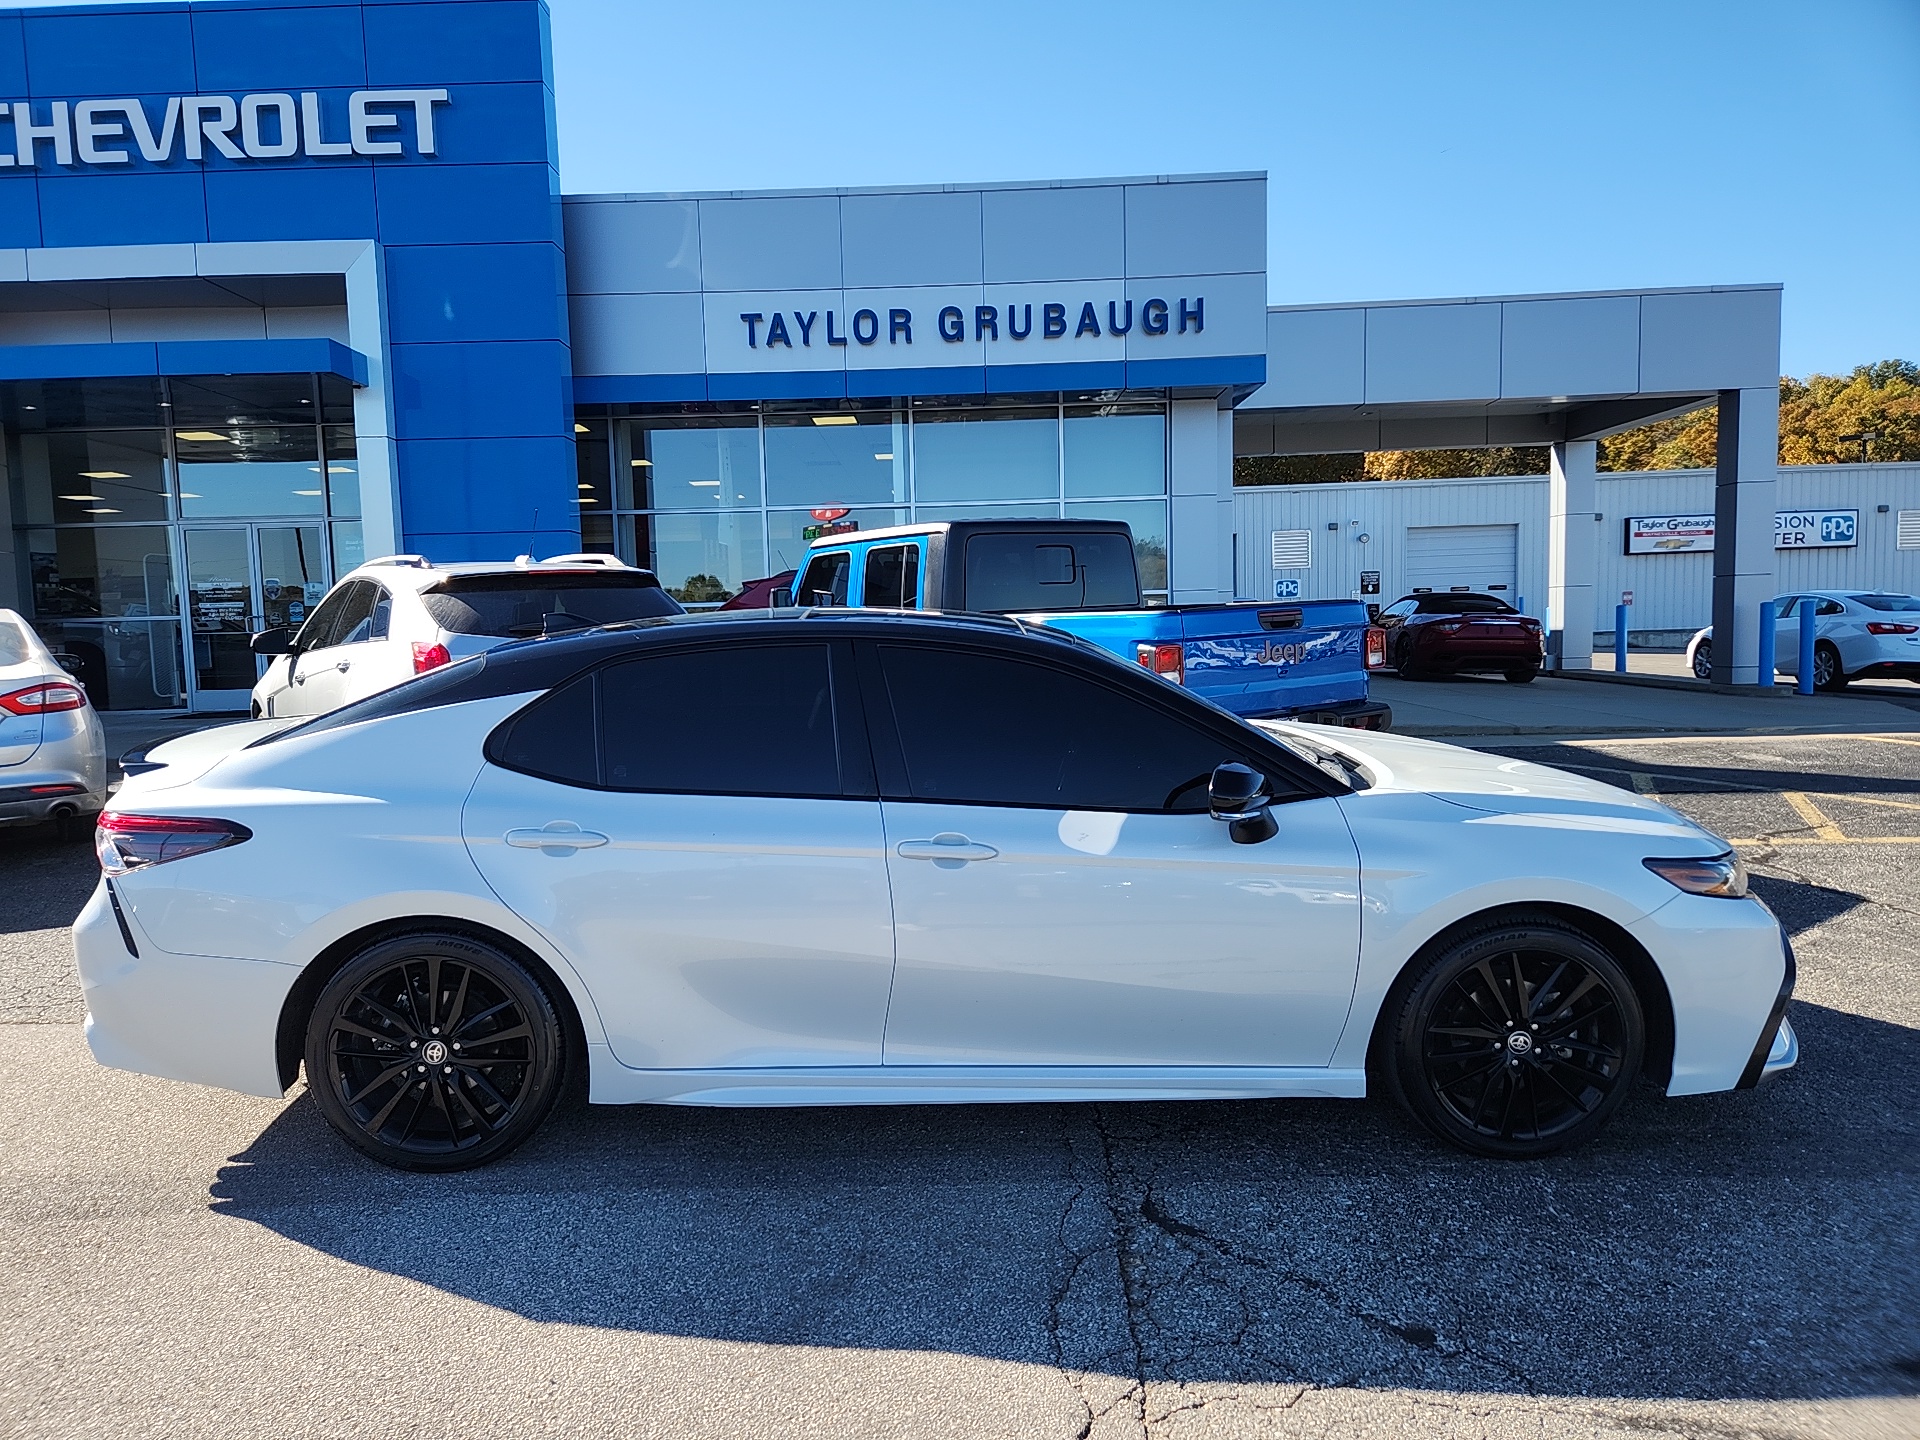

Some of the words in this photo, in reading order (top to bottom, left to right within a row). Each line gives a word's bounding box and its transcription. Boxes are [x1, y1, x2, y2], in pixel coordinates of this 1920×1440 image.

[0, 88, 450, 167] HEVROLET
[740, 308, 913, 349] TAYLOR
[938, 296, 1206, 343] GRUBAUGH
[1634, 519, 1666, 531] Taylor
[1666, 518, 1715, 530] Grubaugh
[1822, 517, 1854, 540] PPG
[1277, 581, 1298, 596] PPG
[1257, 639, 1307, 665] Jeep
[1460, 932, 1529, 960] IRONMAN
